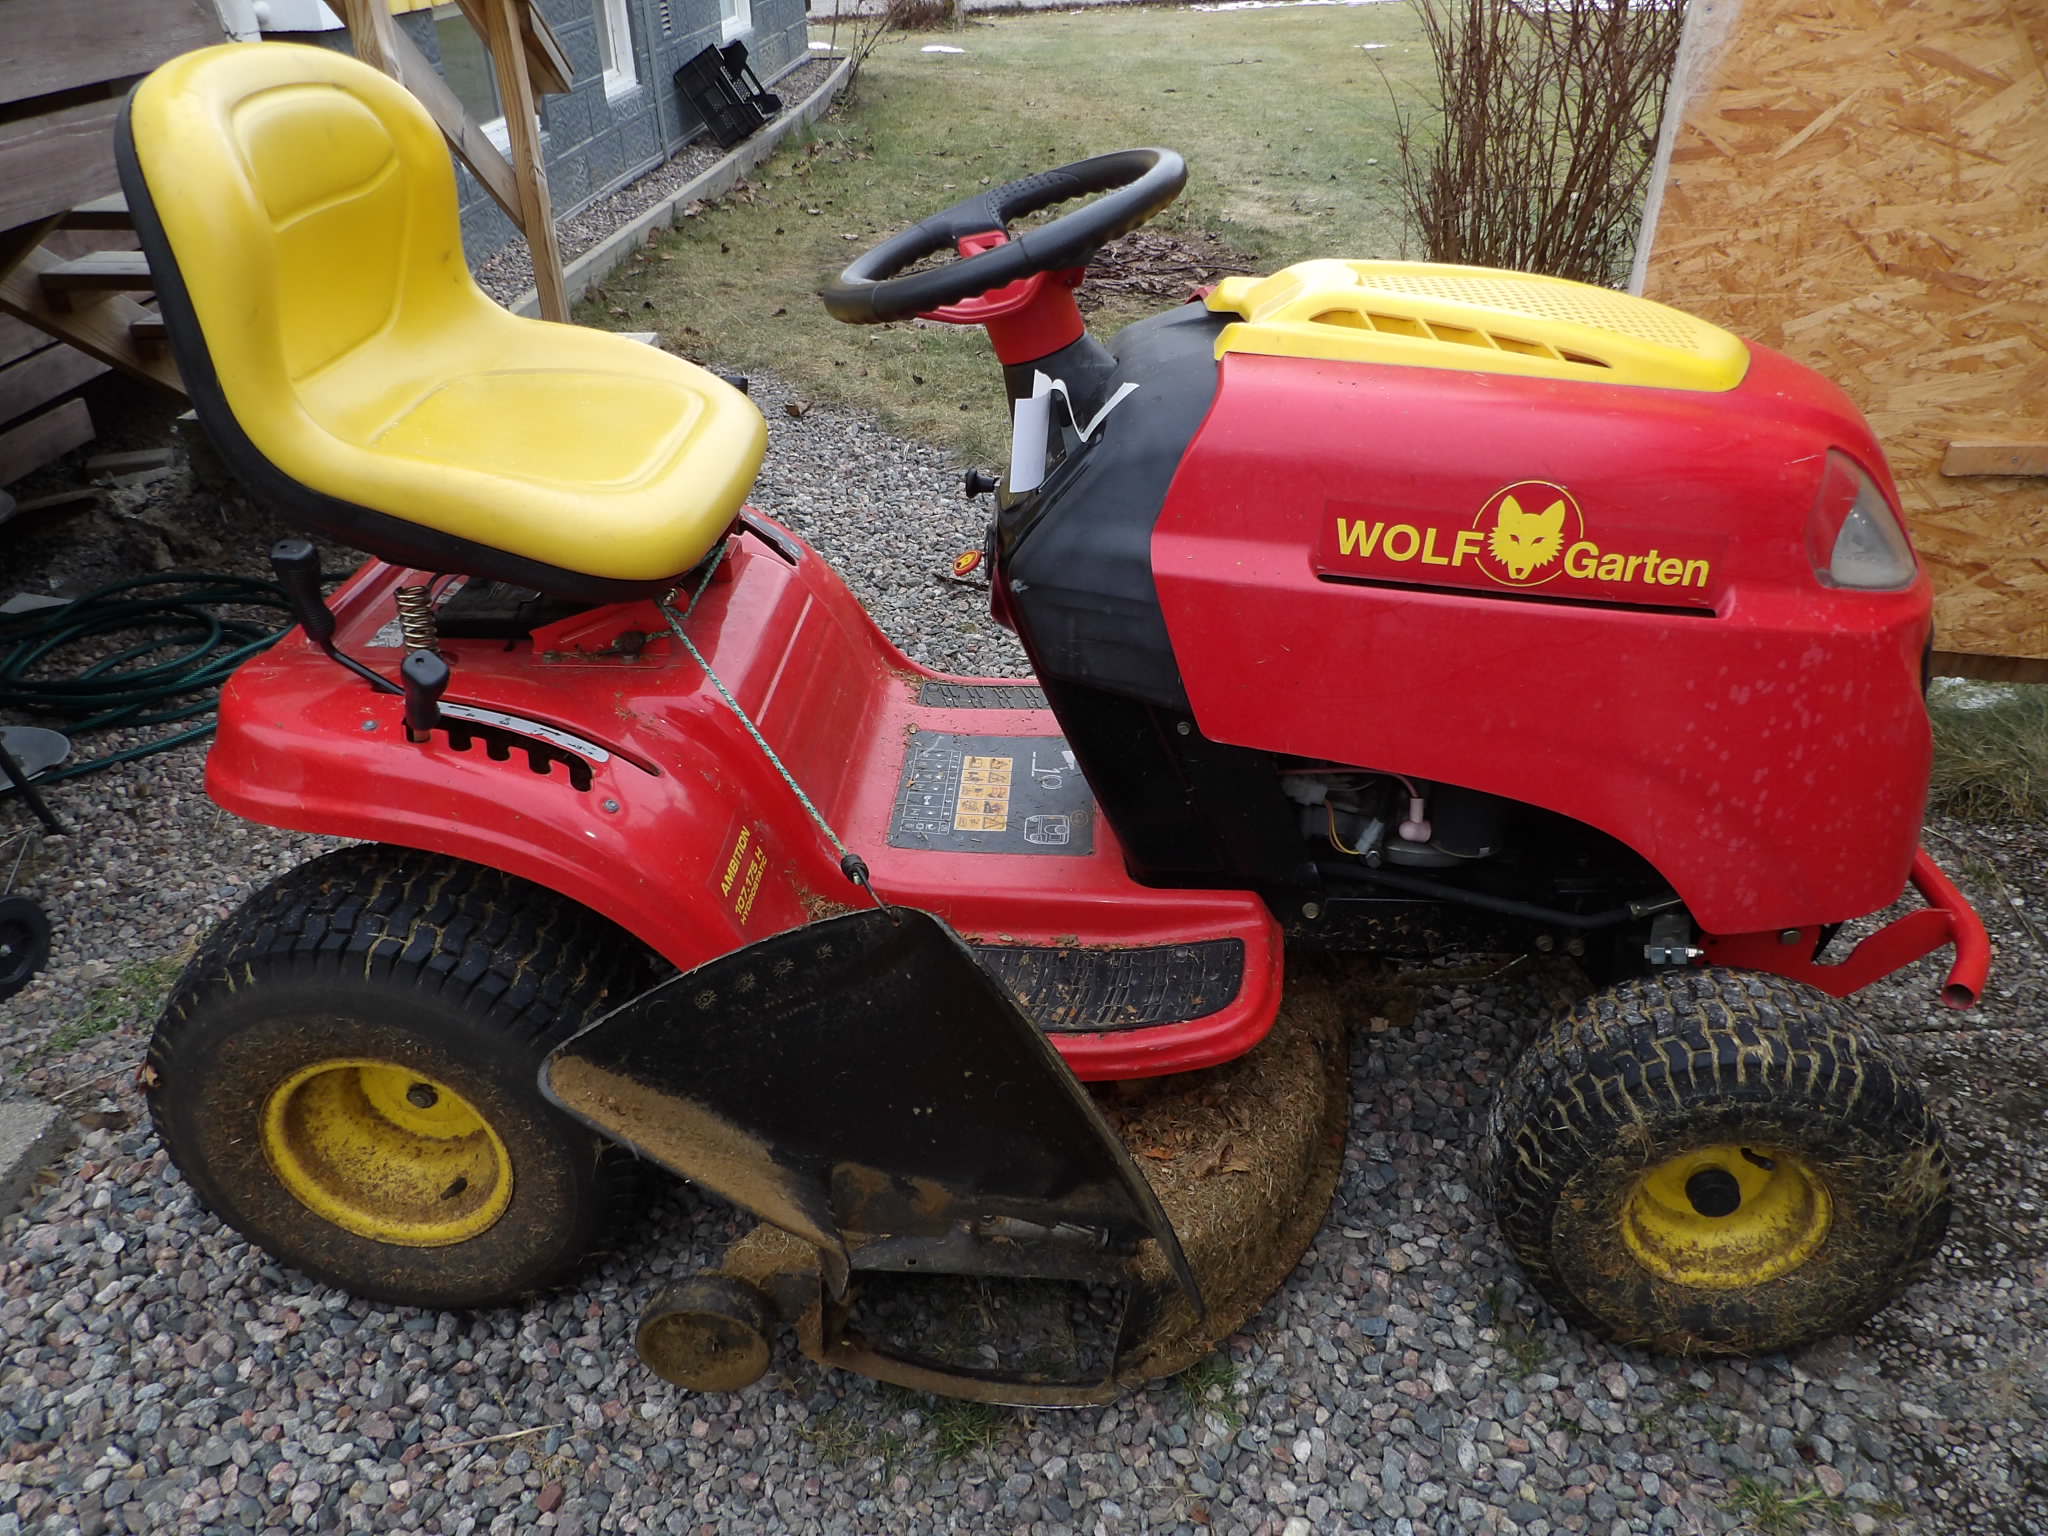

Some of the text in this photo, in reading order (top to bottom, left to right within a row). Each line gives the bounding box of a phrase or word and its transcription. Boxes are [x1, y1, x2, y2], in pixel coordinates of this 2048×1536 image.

[1336, 516, 1711, 588] WOLF Garten
[721, 825, 751, 897] AMBITION
[754, 845, 764, 860] H
[740, 855, 768, 925] HYDROSTATIC
